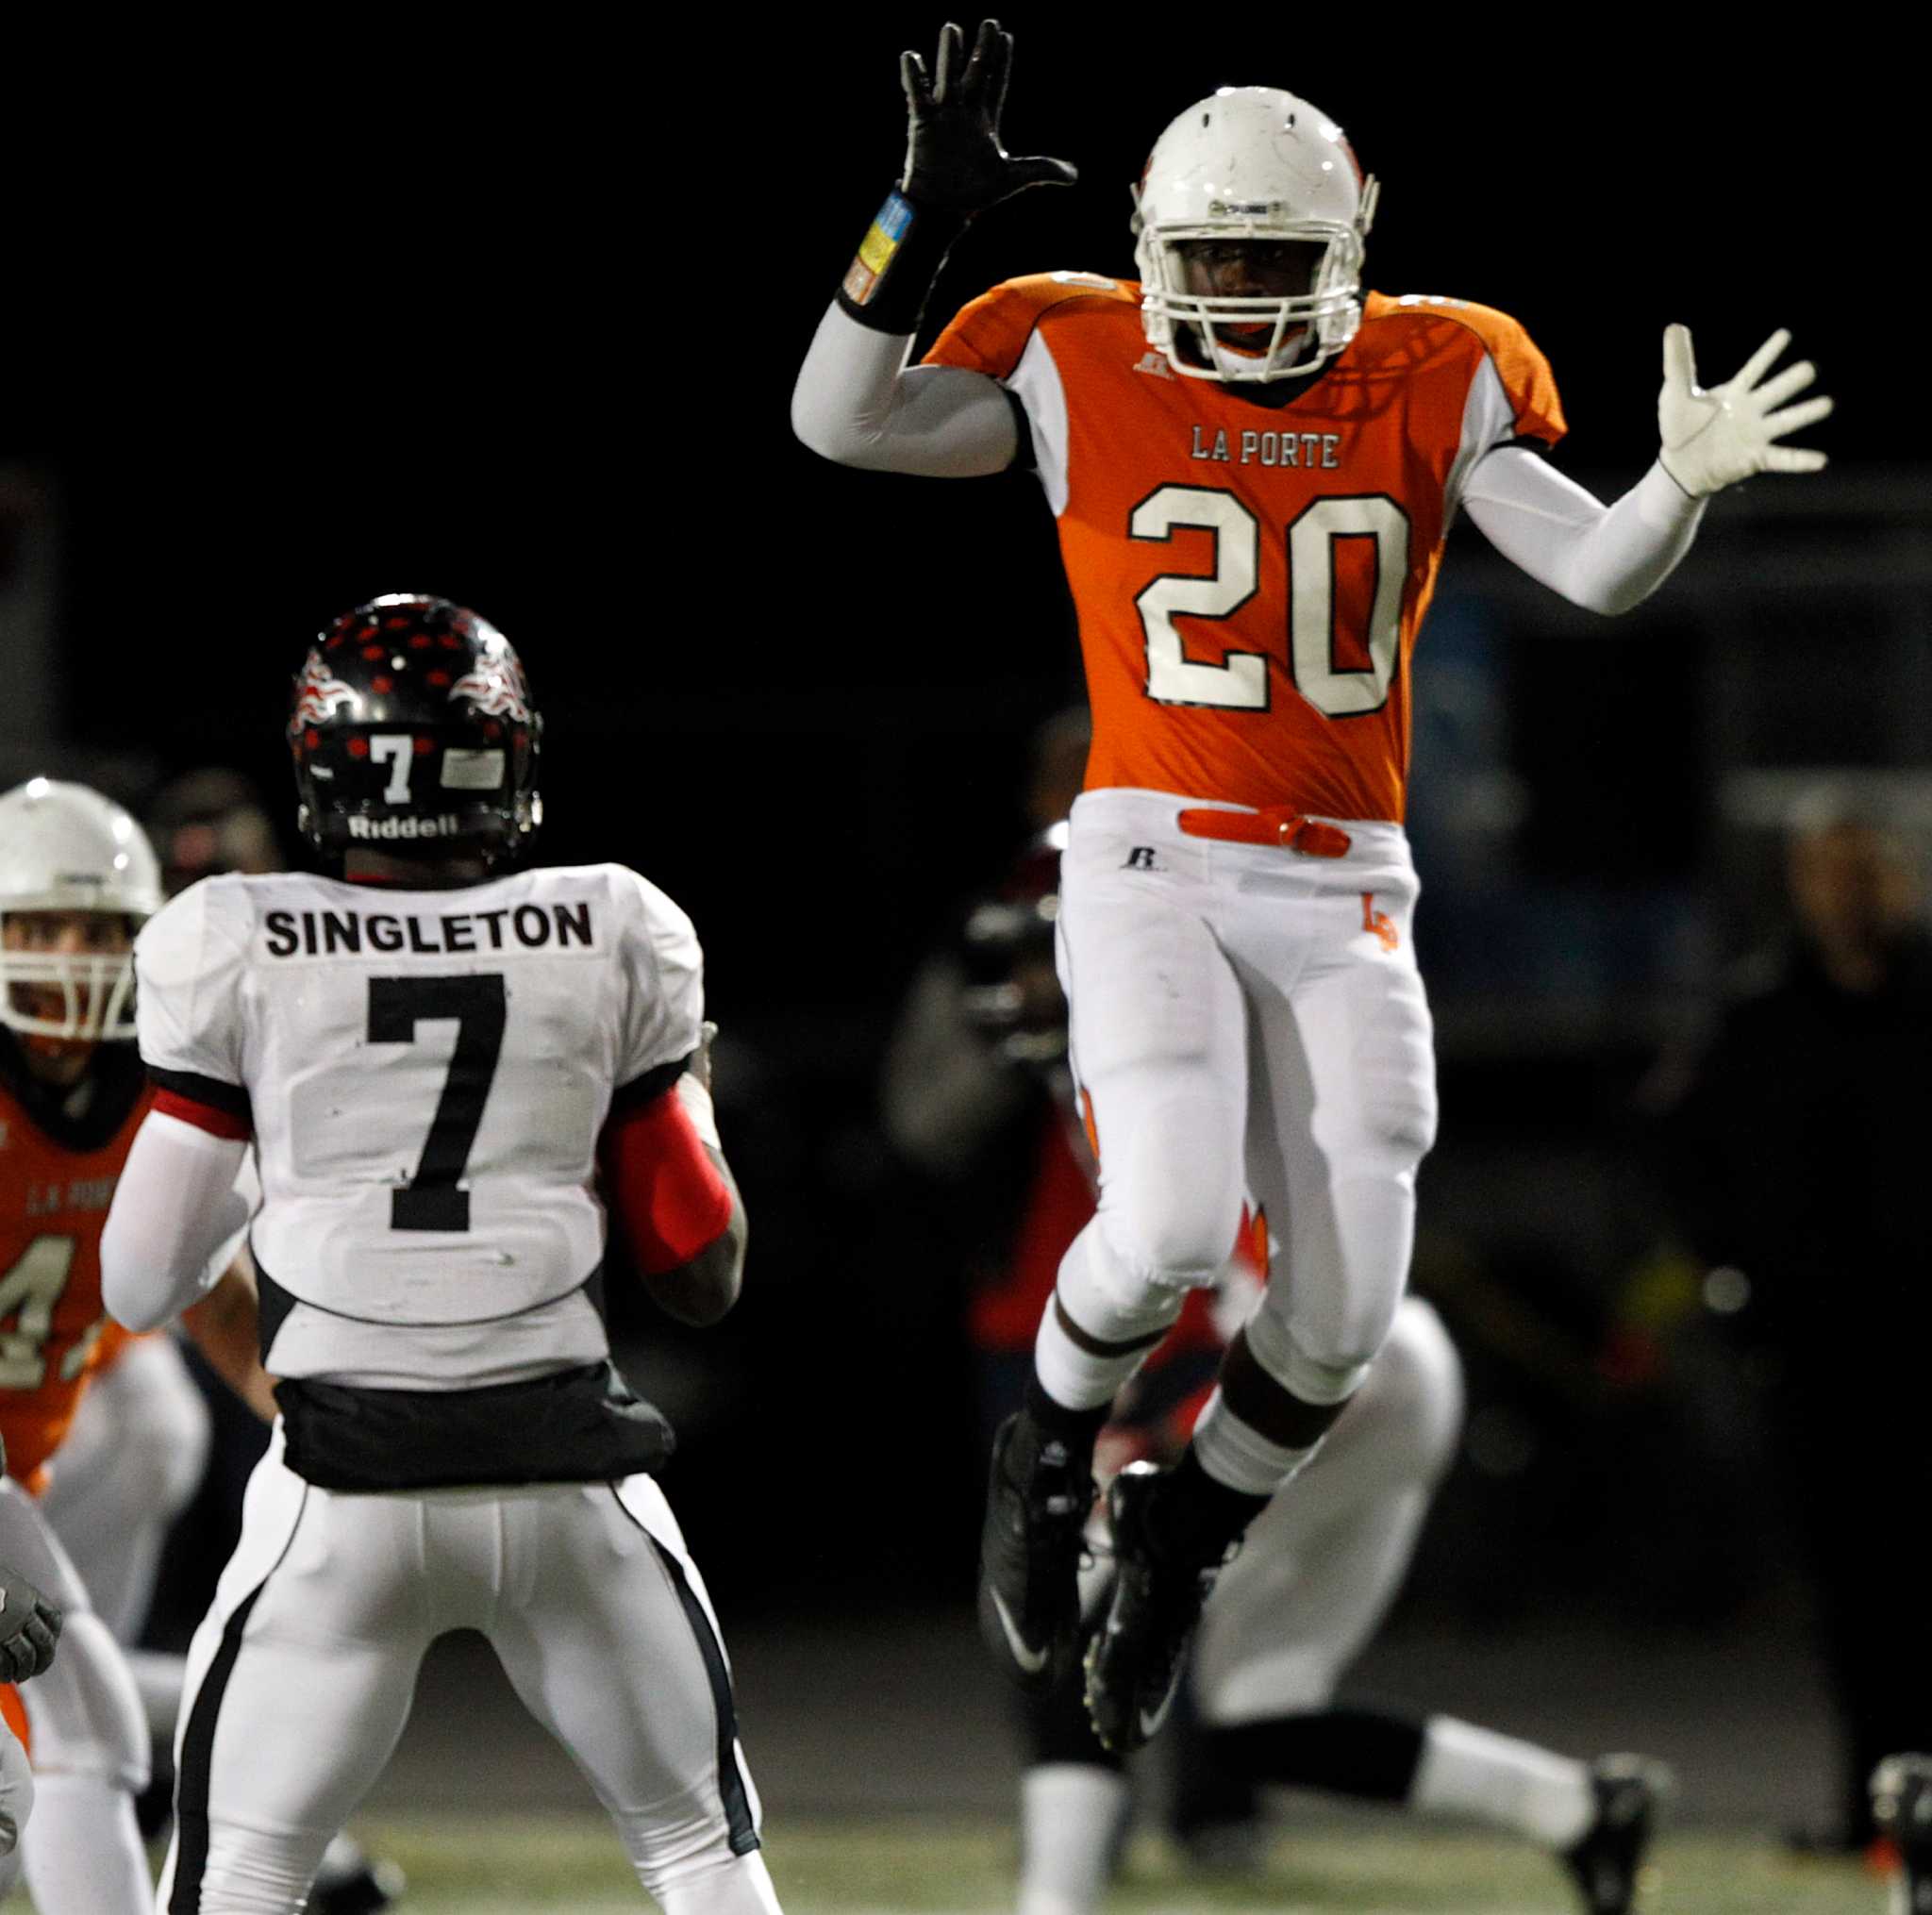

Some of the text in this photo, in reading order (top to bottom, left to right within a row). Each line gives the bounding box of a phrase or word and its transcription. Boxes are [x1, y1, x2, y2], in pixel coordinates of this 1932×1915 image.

[1191, 425, 1341, 469] LA PORTE
[1127, 481, 1410, 721] 20
[369, 734, 413, 805] 7
[347, 814, 459, 840] Riddell
[264, 903, 594, 957] SINGLETON
[366, 973, 507, 1232] 7
